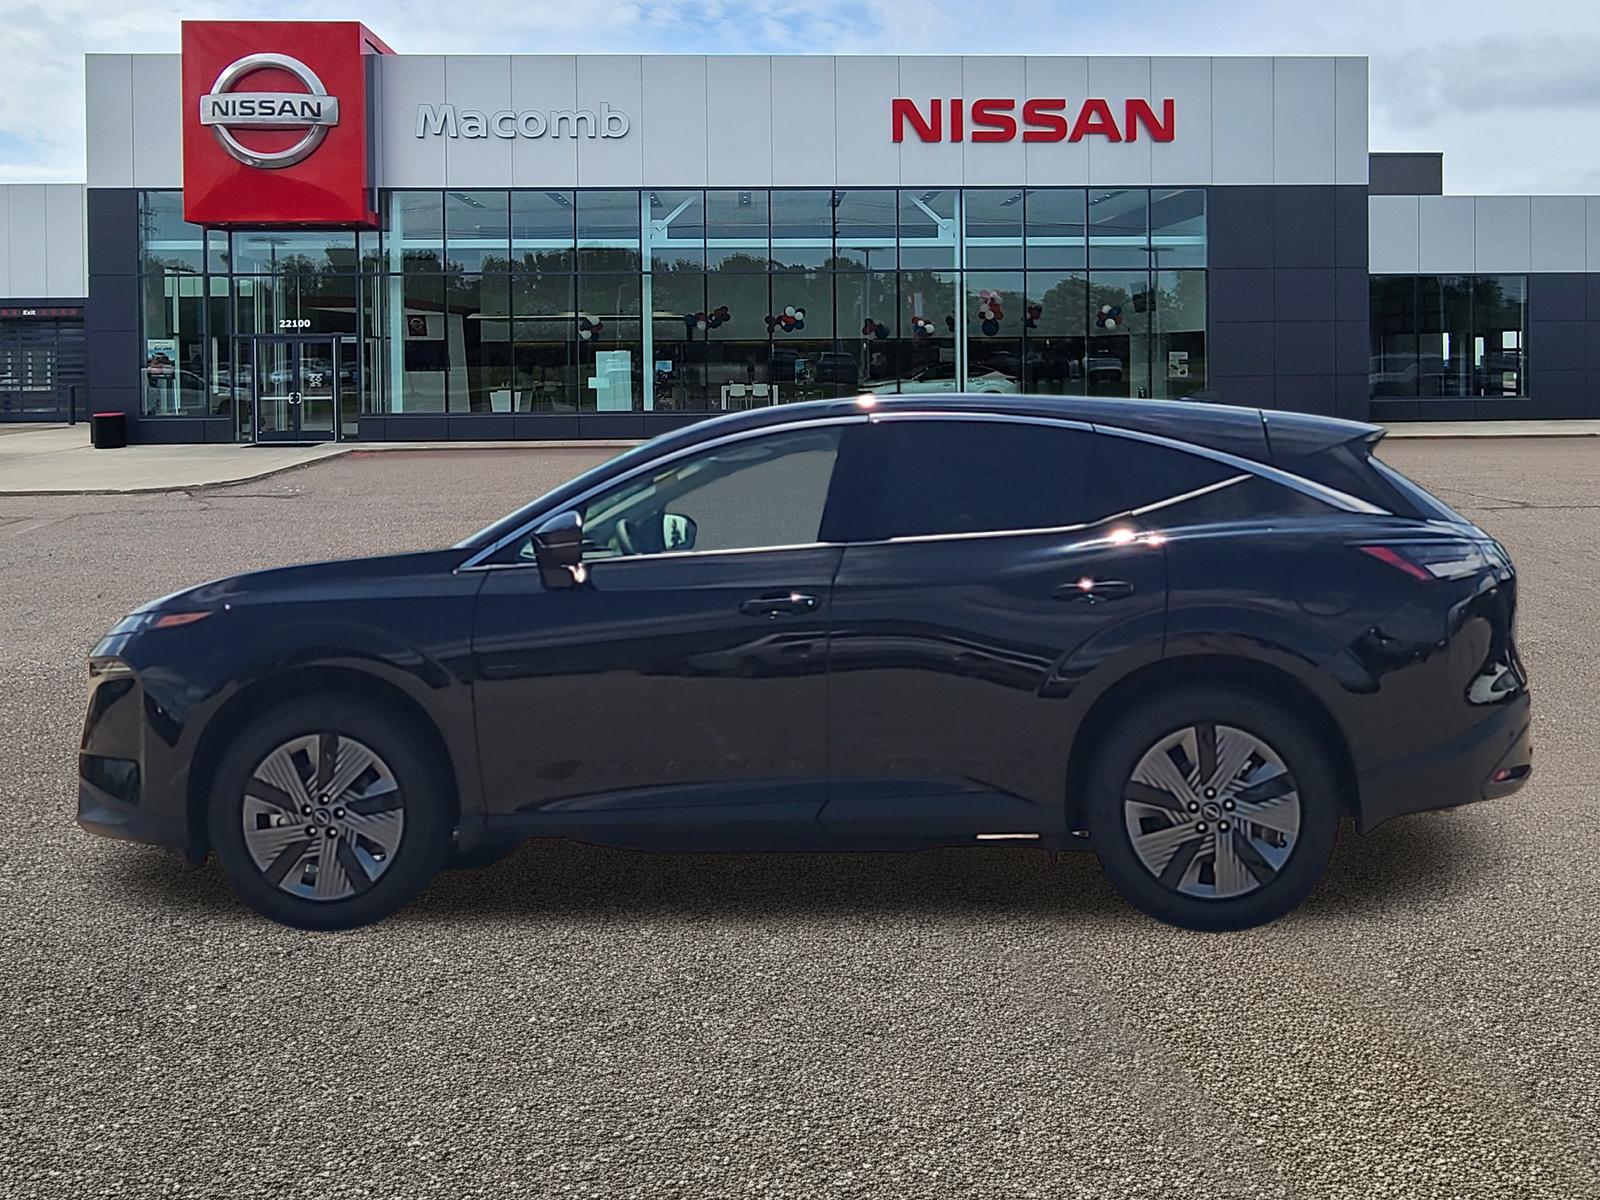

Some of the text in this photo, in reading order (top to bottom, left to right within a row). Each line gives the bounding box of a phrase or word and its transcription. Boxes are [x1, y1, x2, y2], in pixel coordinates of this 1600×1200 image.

[211, 99, 323, 118] NISSAN
[414, 102, 630, 139] Macomb
[892, 97, 1176, 143] NISSAN
[279, 319, 311, 328] 22100
